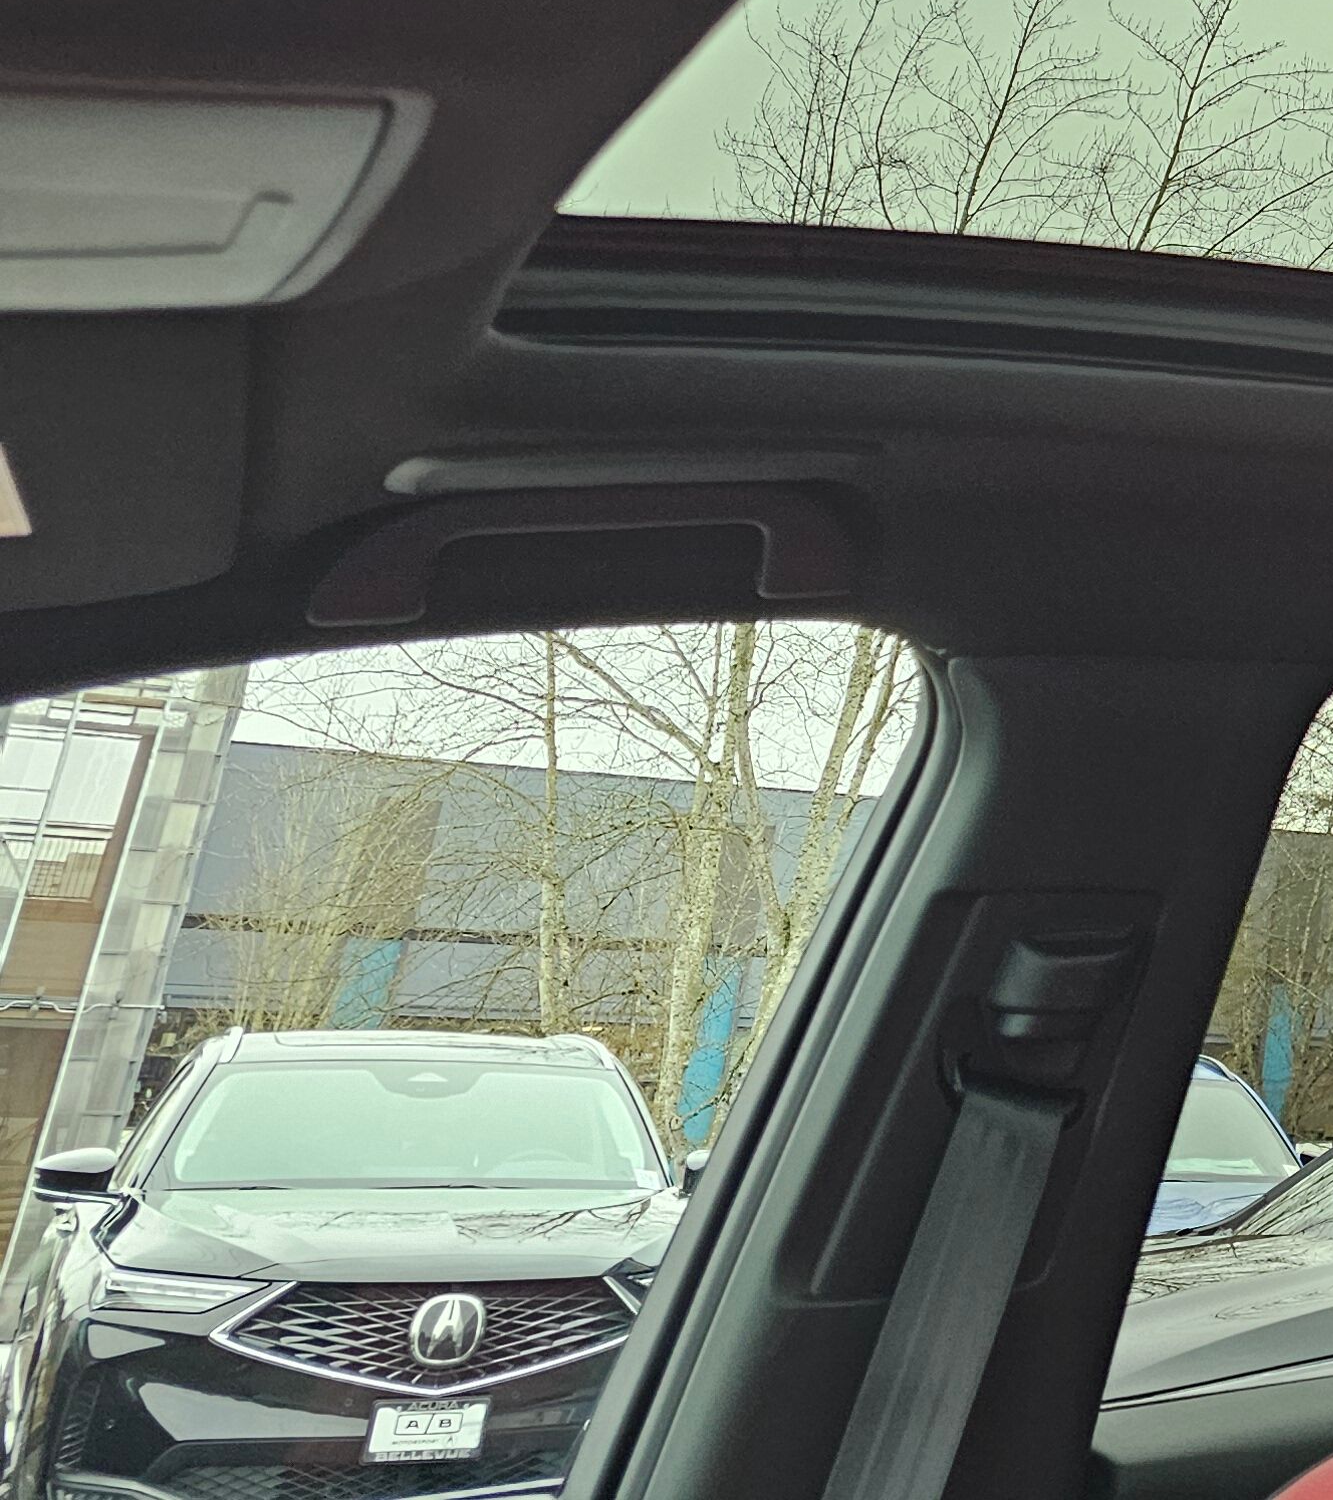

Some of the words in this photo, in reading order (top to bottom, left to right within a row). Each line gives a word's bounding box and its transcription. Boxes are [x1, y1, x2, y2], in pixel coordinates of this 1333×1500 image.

[406, 1401, 460, 1411] ACURA
[406, 1420, 419, 1429] A
[439, 1419, 452, 1428] B
[375, 1449, 471, 1462] BELLEVUE
